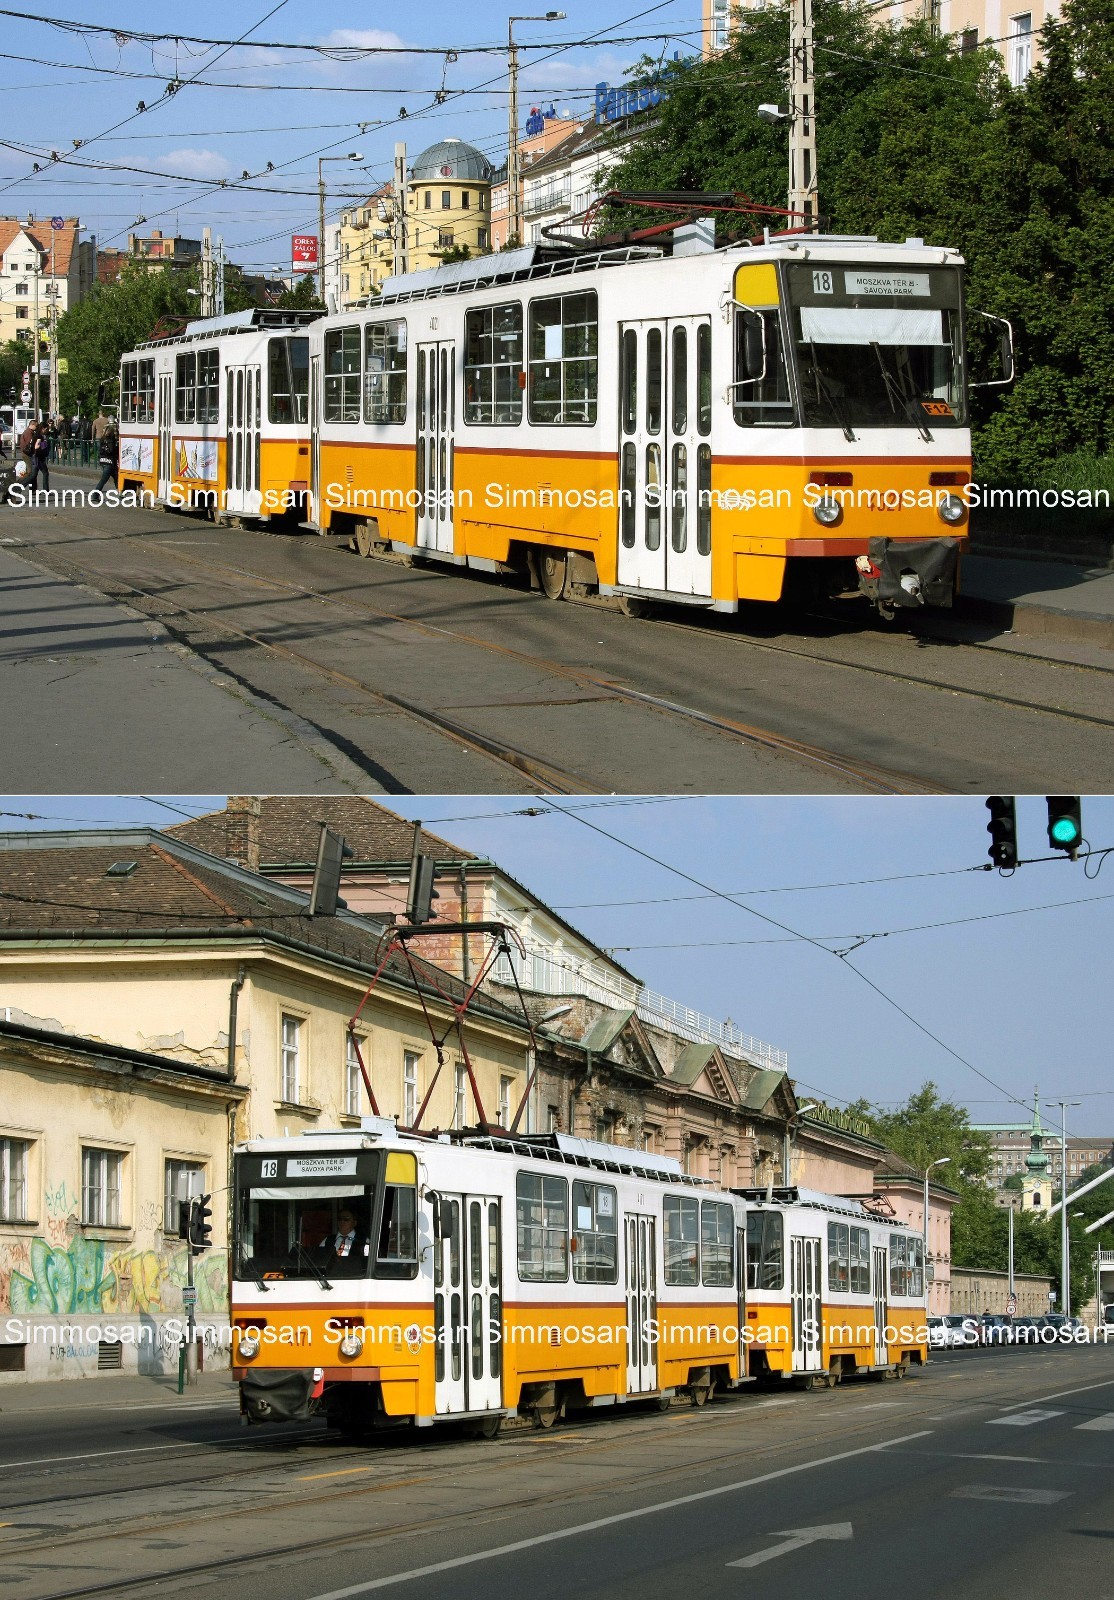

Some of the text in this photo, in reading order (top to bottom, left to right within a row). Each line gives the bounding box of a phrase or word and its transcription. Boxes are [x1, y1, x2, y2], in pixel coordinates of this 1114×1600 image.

[813, 272, 831, 292] 18
[856, 278, 891, 287] MOSZKVA
[863, 286, 892, 295] SAVOYA
[923, 404, 952, 414] F12
[263, 1161, 276, 1177] 18
